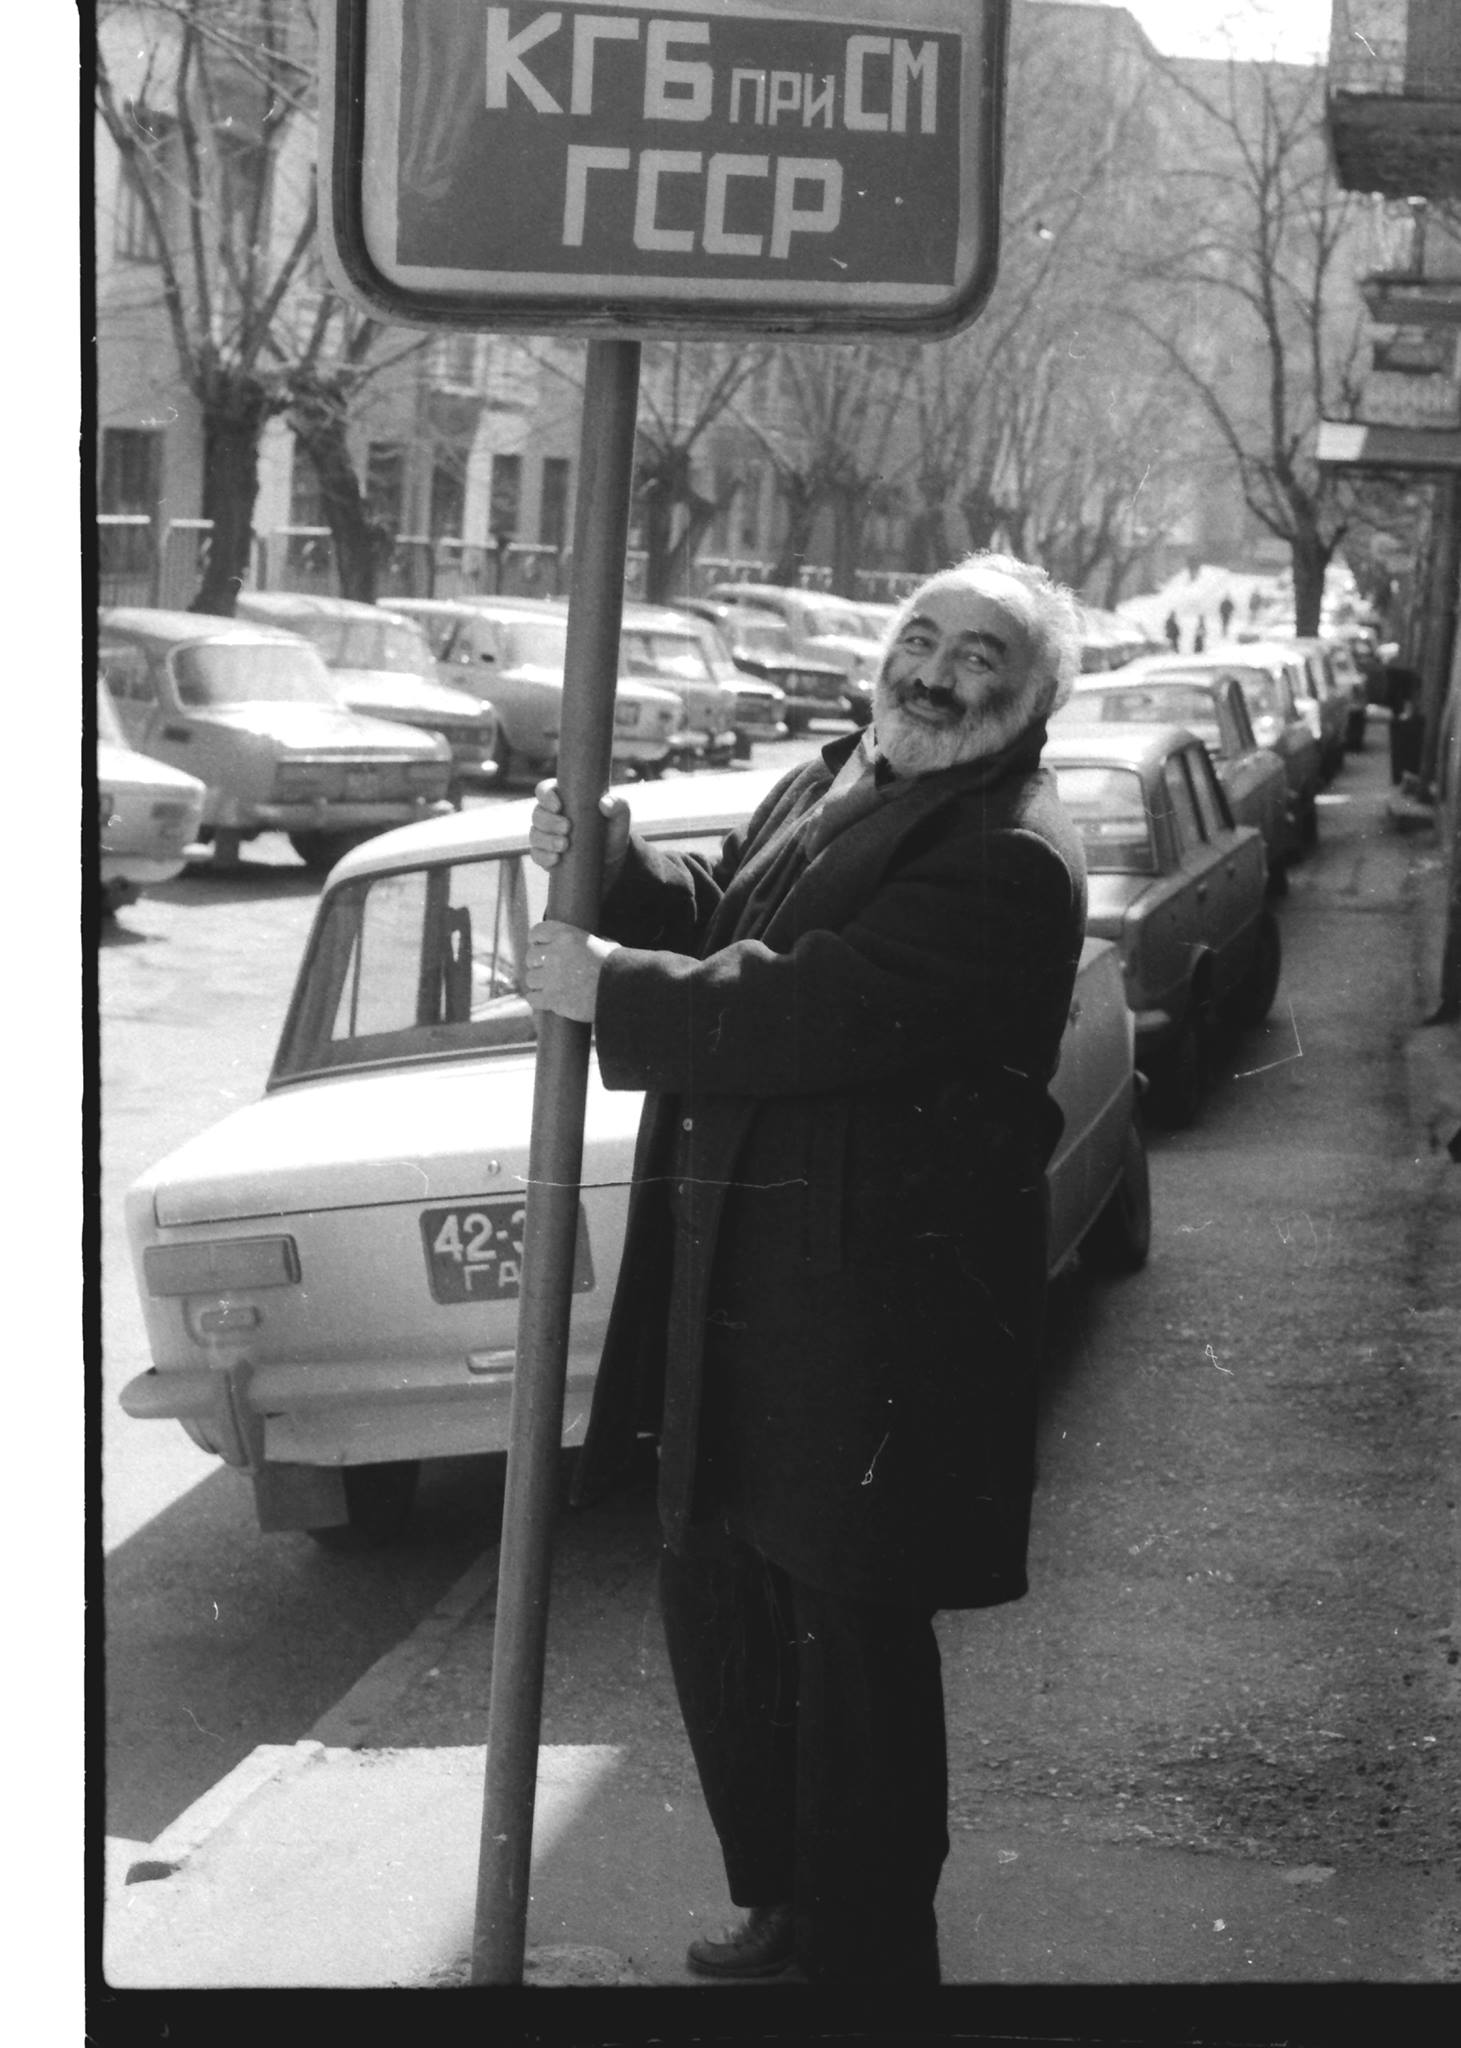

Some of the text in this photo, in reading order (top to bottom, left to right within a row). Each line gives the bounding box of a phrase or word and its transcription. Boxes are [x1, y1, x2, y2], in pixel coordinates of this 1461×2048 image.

[485, 7, 714, 122] КГБ
[844, 35, 940, 134] СМ
[562, 144, 844, 259] ГССР
